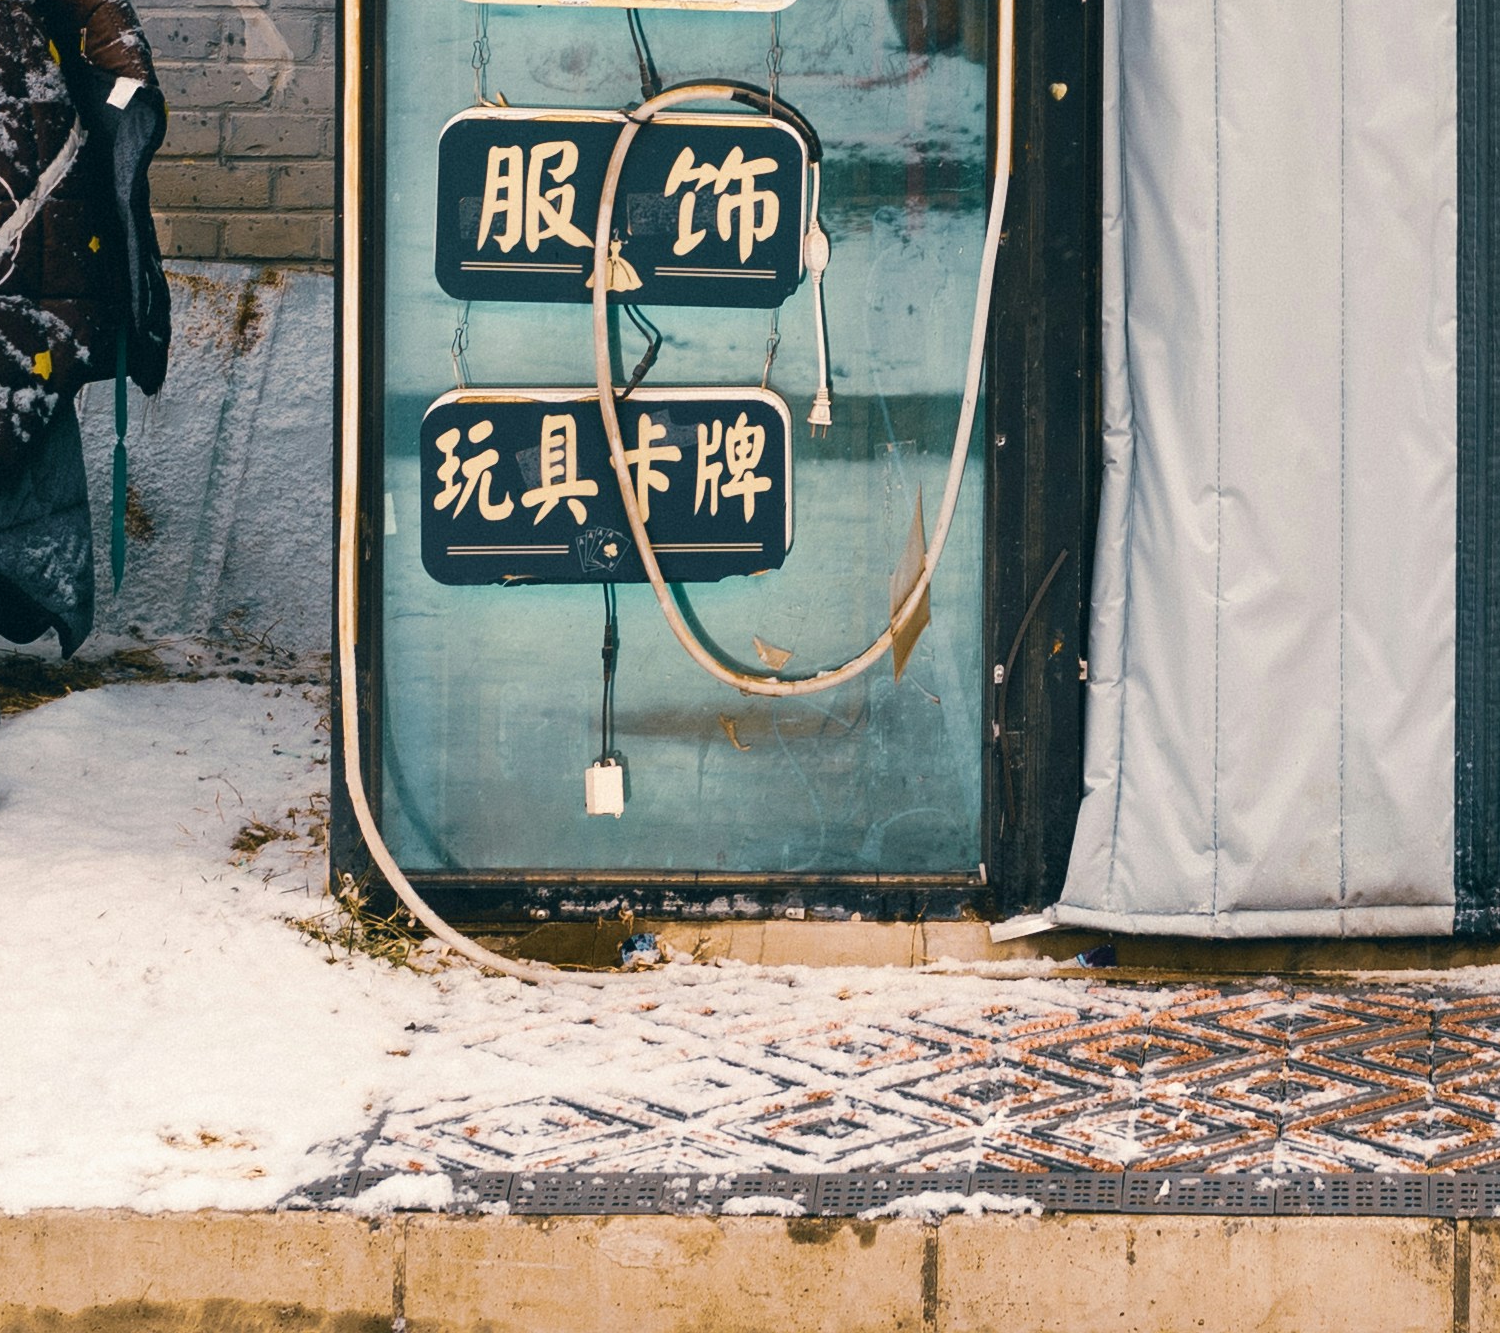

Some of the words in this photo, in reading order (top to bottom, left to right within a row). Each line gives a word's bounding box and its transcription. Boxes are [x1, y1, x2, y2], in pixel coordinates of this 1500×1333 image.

[477, 140, 779, 264] 服饰
[433, 411, 773, 527] 玩具卡牌
